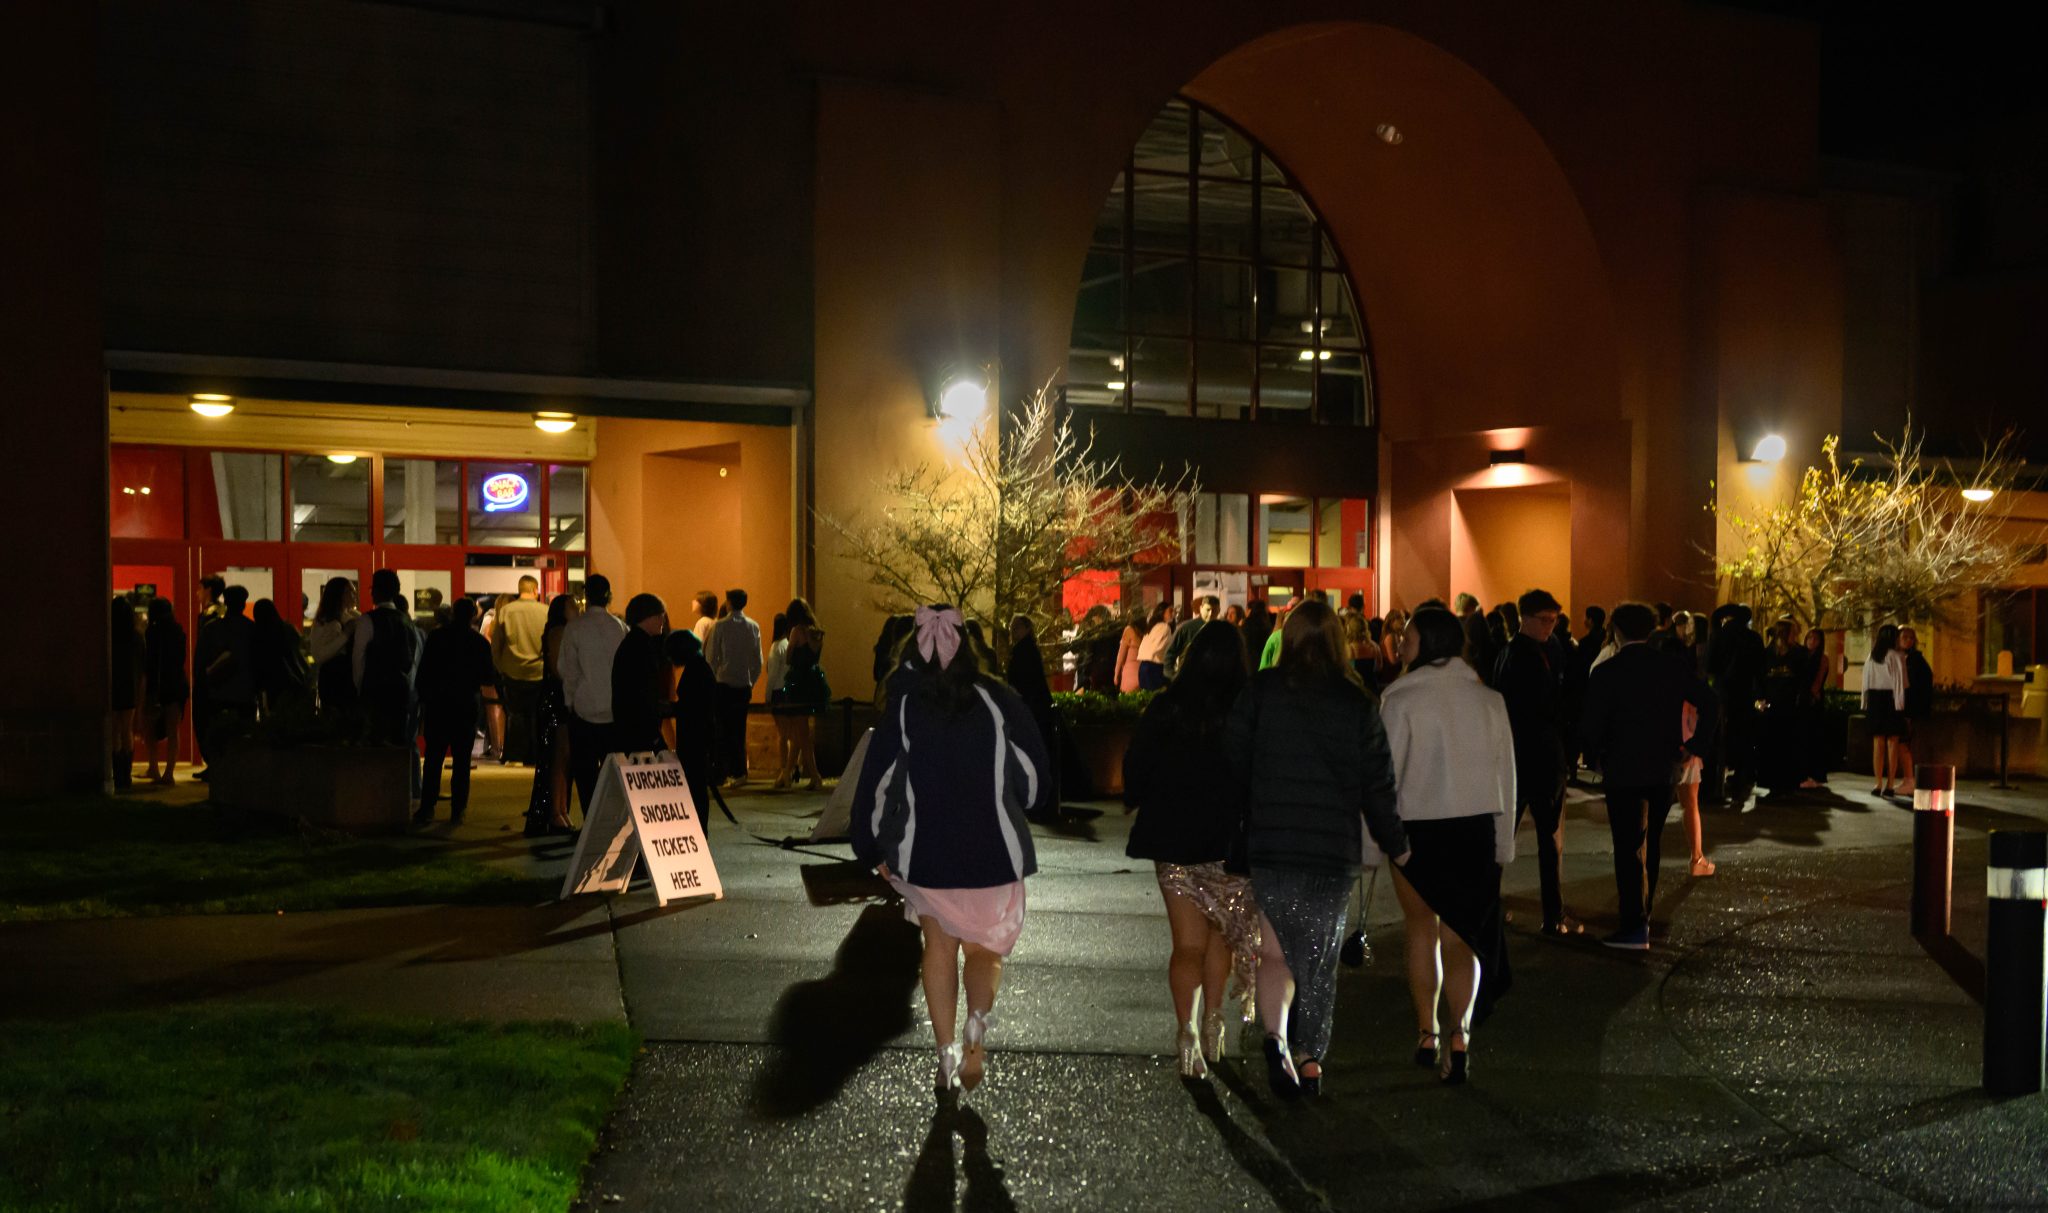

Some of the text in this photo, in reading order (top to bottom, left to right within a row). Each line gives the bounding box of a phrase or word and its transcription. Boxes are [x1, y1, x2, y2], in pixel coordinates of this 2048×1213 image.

[625, 769, 684, 791] PURCHASE
[640, 802, 690, 824] SNOBALL
[652, 835, 699, 858] TICKETS
[671, 870, 701, 890] HERE
